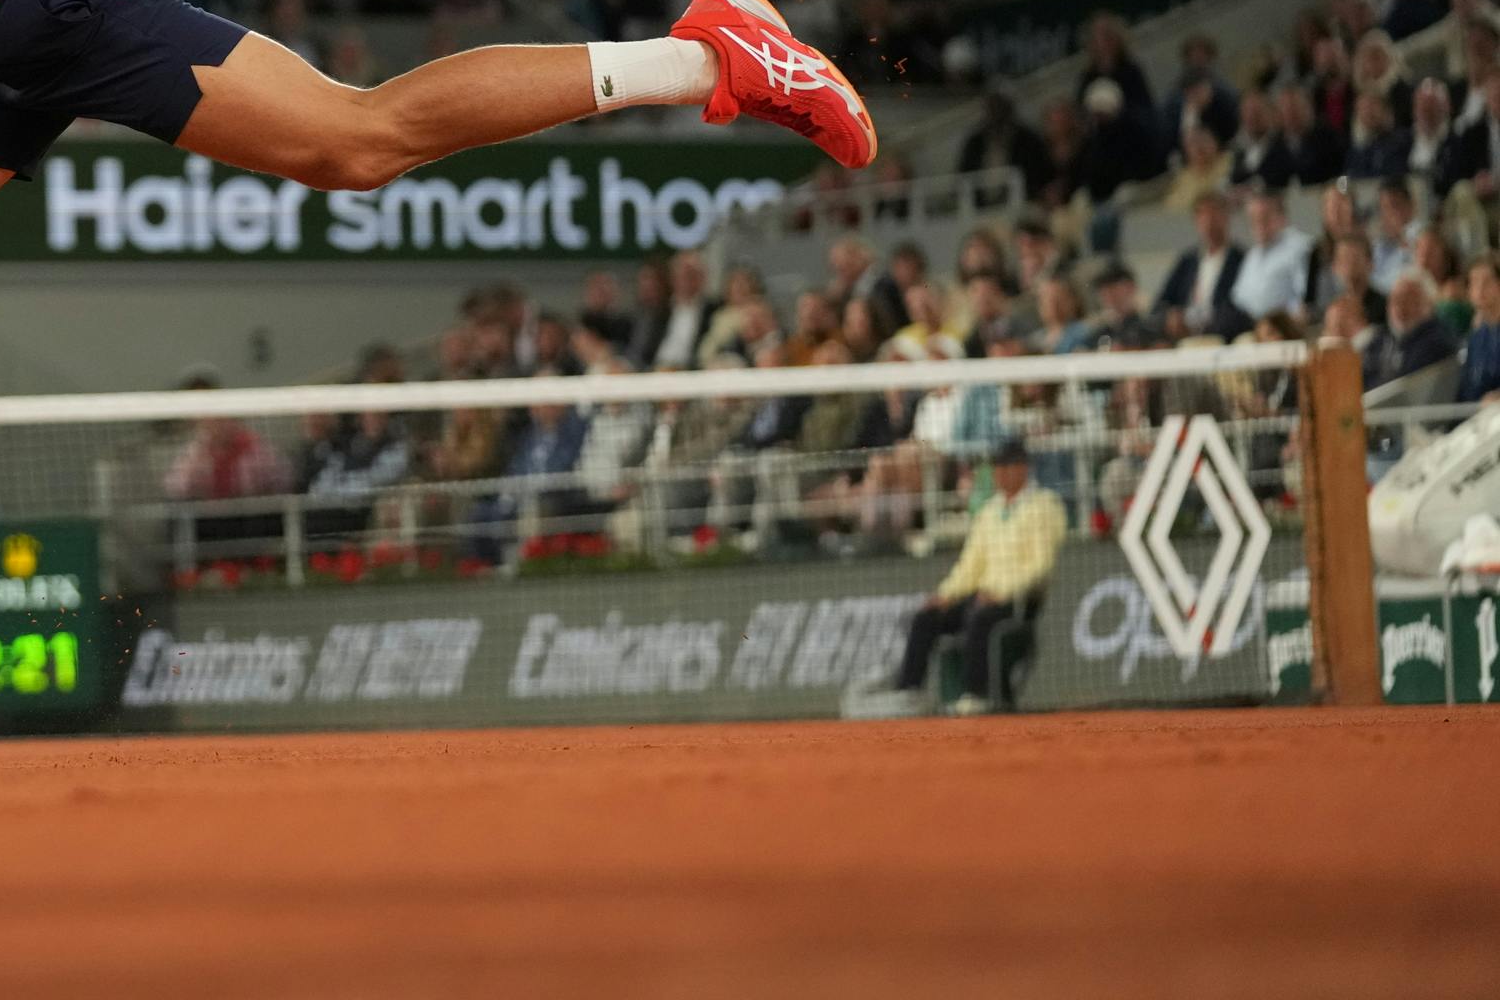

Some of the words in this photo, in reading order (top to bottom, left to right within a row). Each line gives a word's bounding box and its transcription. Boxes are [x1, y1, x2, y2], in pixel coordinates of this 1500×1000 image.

[45, 153, 308, 253] Haier
[327, 157, 589, 251] smart
[601, 157, 785, 250] hom
